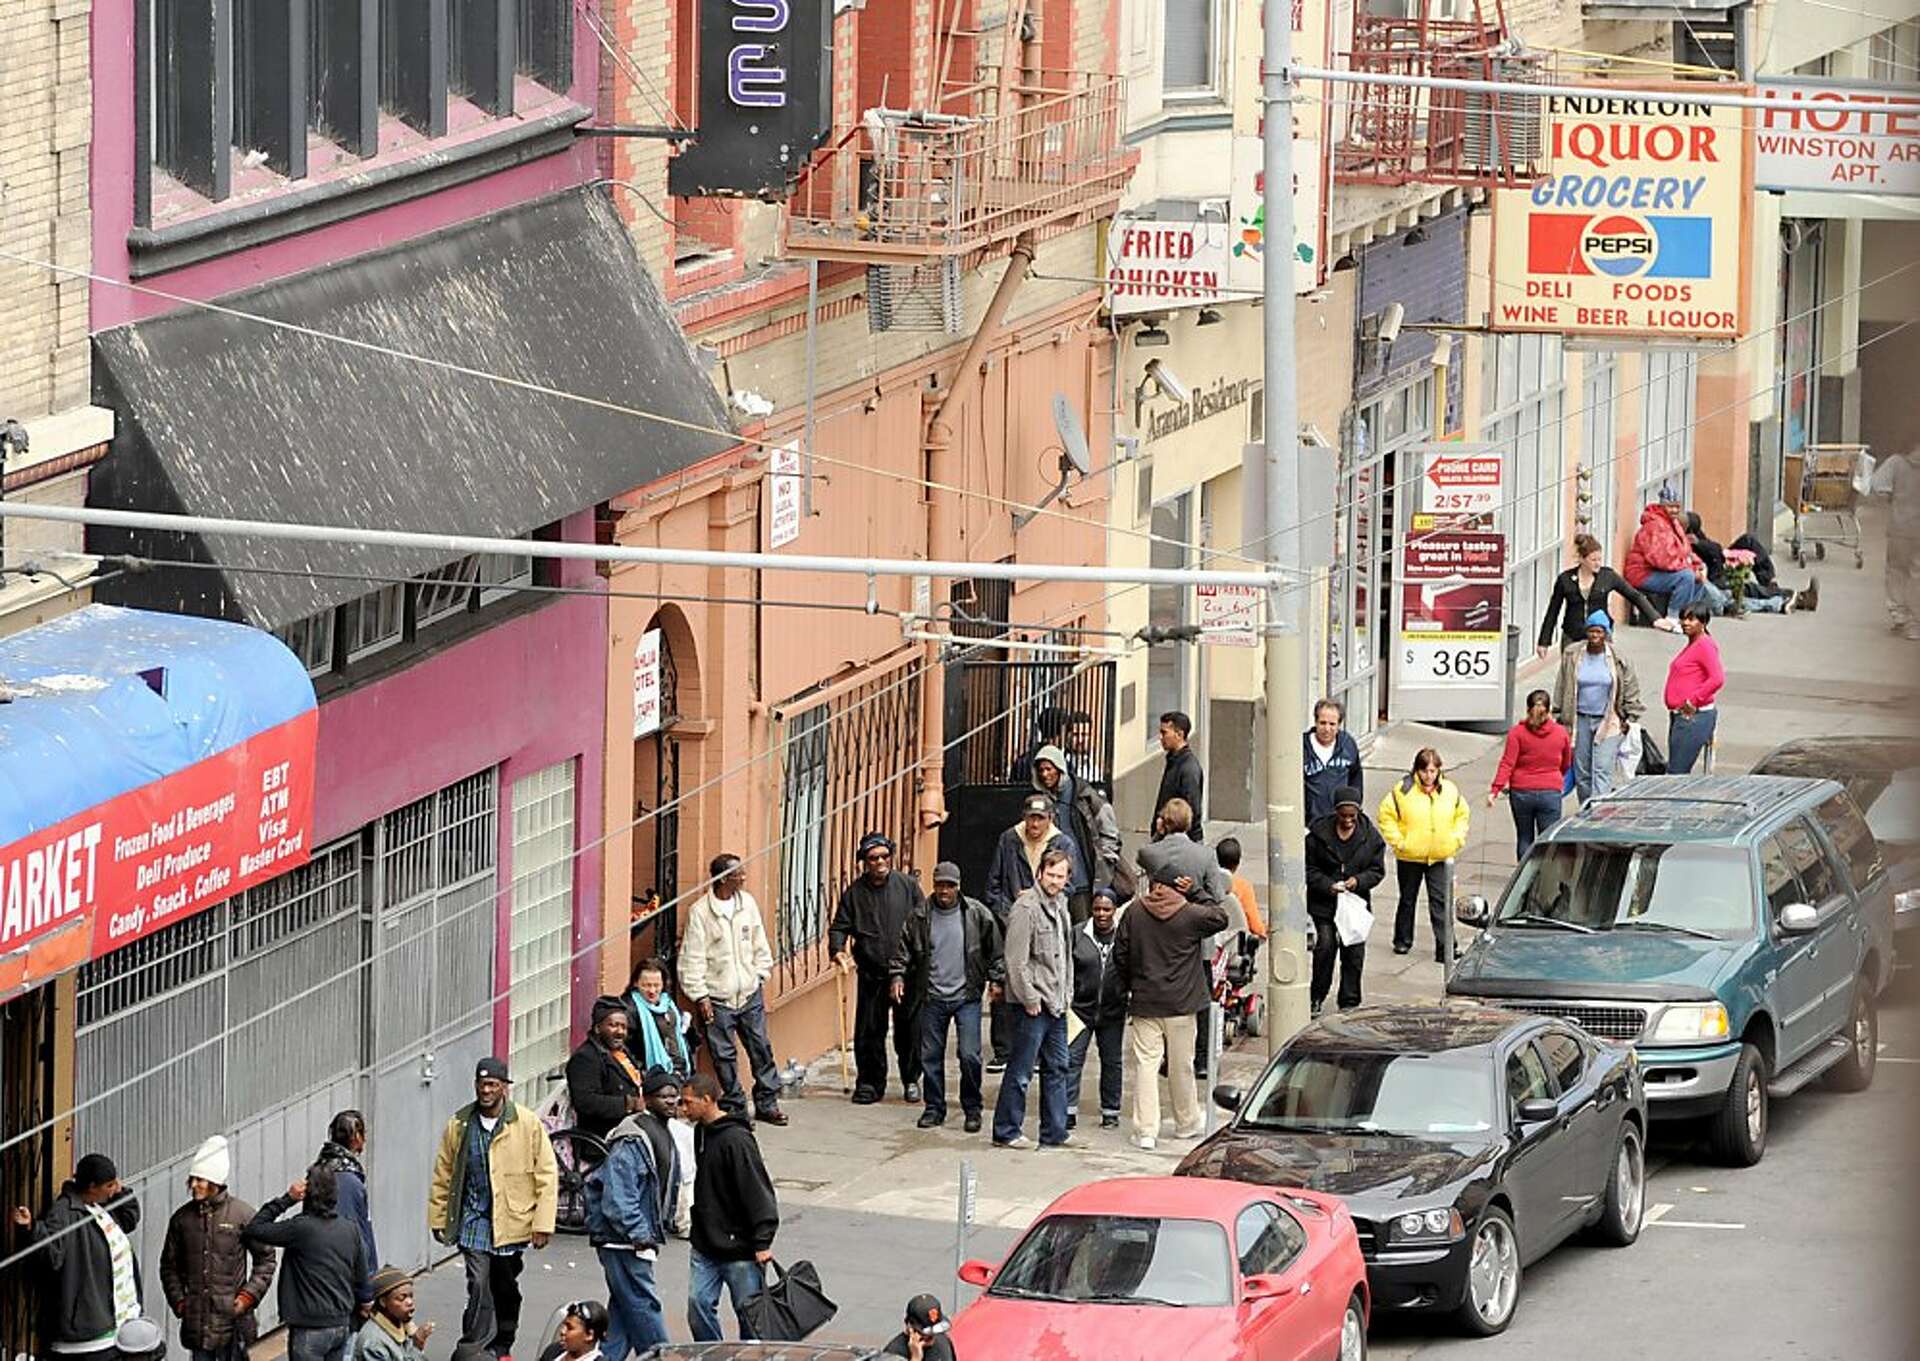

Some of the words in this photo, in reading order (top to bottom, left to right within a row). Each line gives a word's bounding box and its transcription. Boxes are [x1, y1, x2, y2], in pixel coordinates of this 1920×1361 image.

[1549, 95, 1713, 118] ENDERLOIN
[1552, 122, 1719, 168] IQUOR
[1757, 135, 1876, 160] WINSTON
[1830, 162, 1887, 184] APT.
[1532, 174, 1707, 210] GROCERY
[1121, 228, 1195, 260] FRIED
[1585, 236, 1653, 254] PEPSI
[1109, 267, 1219, 299] CHICKEN
[1526, 281, 1573, 299] DELI
[1613, 282, 1692, 302] FOODS
[1502, 304, 1559, 324] WINE
[1577, 307, 1629, 326] BEER
[1647, 310, 1736, 330] LIQUOR
[1418, 552, 1448, 563] great
[1451, 551, 1461, 561] in
[1462, 540, 1498, 551] tastes
[263, 761, 290, 792] EBT
[260, 787, 289, 818] ATM
[115, 832, 150, 862] Frozen
[151, 814, 176, 848] Food
[186, 792, 236, 832] Beverages
[259, 817, 288, 845] Visa
[136, 858, 162, 891] Deli
[163, 842, 212, 880] Produce
[239, 846, 276, 878] Master
[277, 828, 304, 860] Card
[0, 822, 103, 943] ARKET
[194, 867, 231, 900] Coffee
